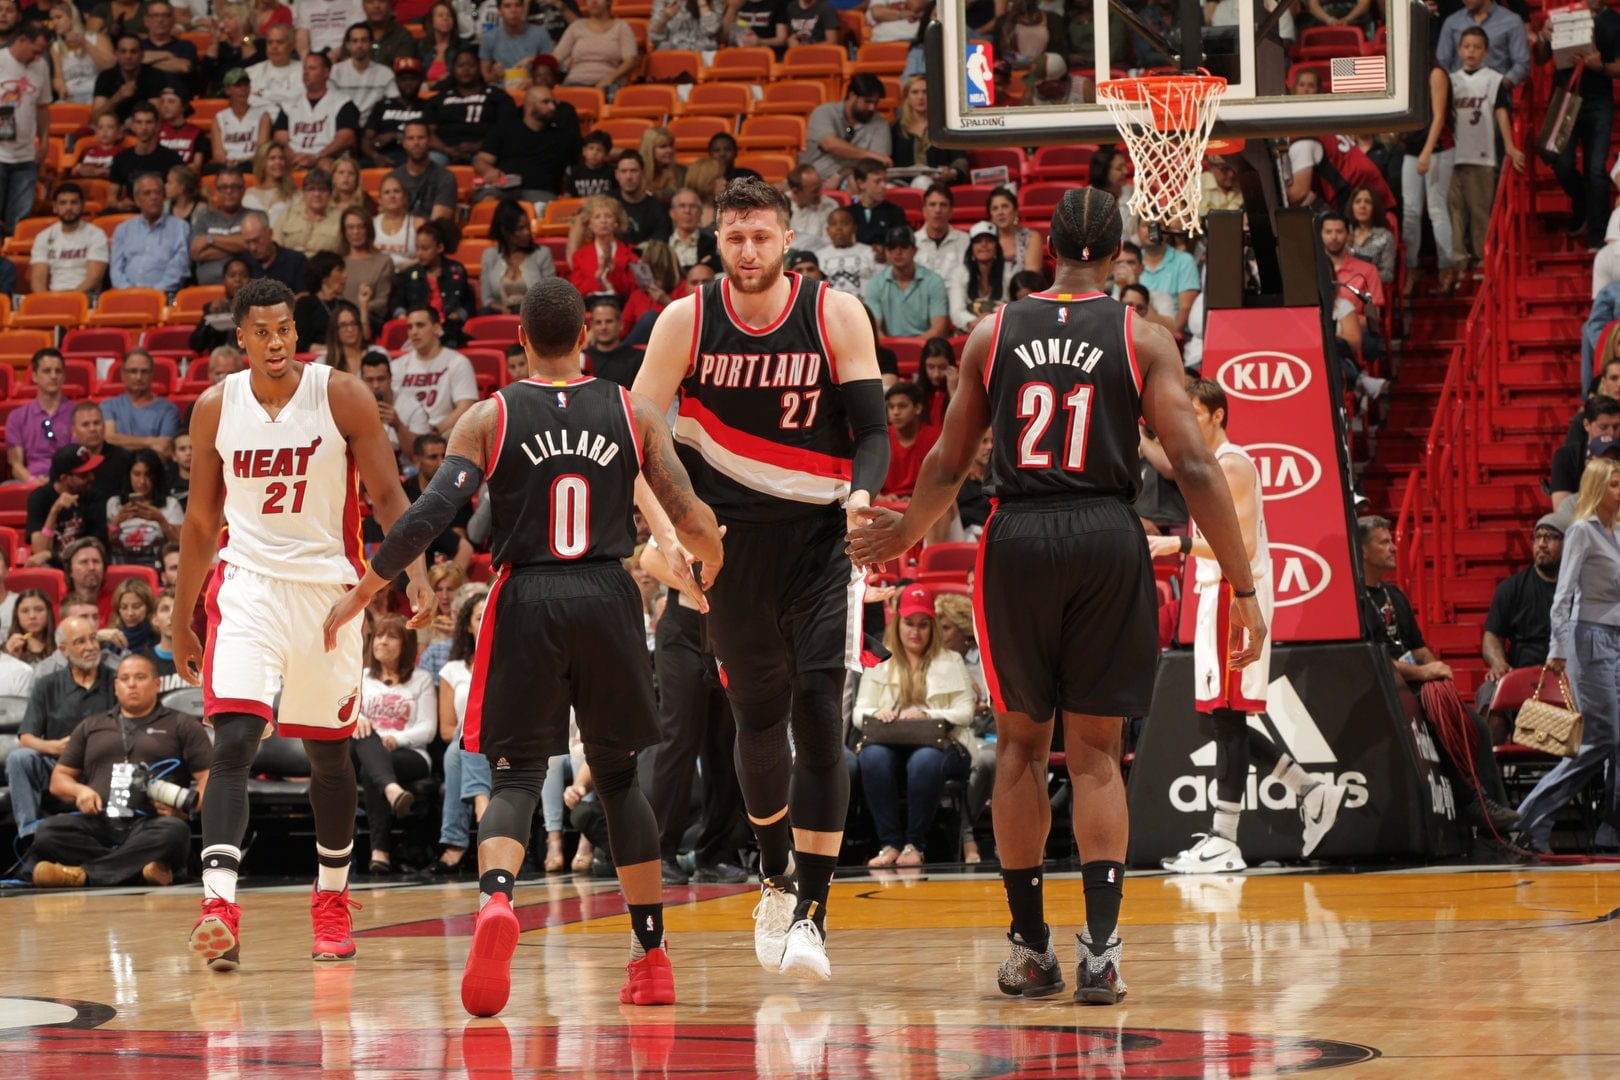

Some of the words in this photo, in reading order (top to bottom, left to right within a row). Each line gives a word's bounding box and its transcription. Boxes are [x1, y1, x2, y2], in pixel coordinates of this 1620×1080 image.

[294, 114, 328, 135] HEAT
[465, 105, 483, 123] 11
[960, 116, 1005, 128] SPALDING
[1469, 110, 1482, 126] 3
[700, 352, 821, 388] PORTLAND
[1014, 338, 1103, 374] VONLEH
[402, 367, 448, 387] HEAT
[1232, 362, 1296, 390] KIA
[779, 388, 821, 429] 27
[1016, 381, 1094, 472] 21
[233, 435, 322, 478] HEAT
[520, 429, 619, 467] LILLARD
[1251, 456, 1303, 487] IA
[262, 480, 307, 514] 21
[550, 473, 591, 559] 0
